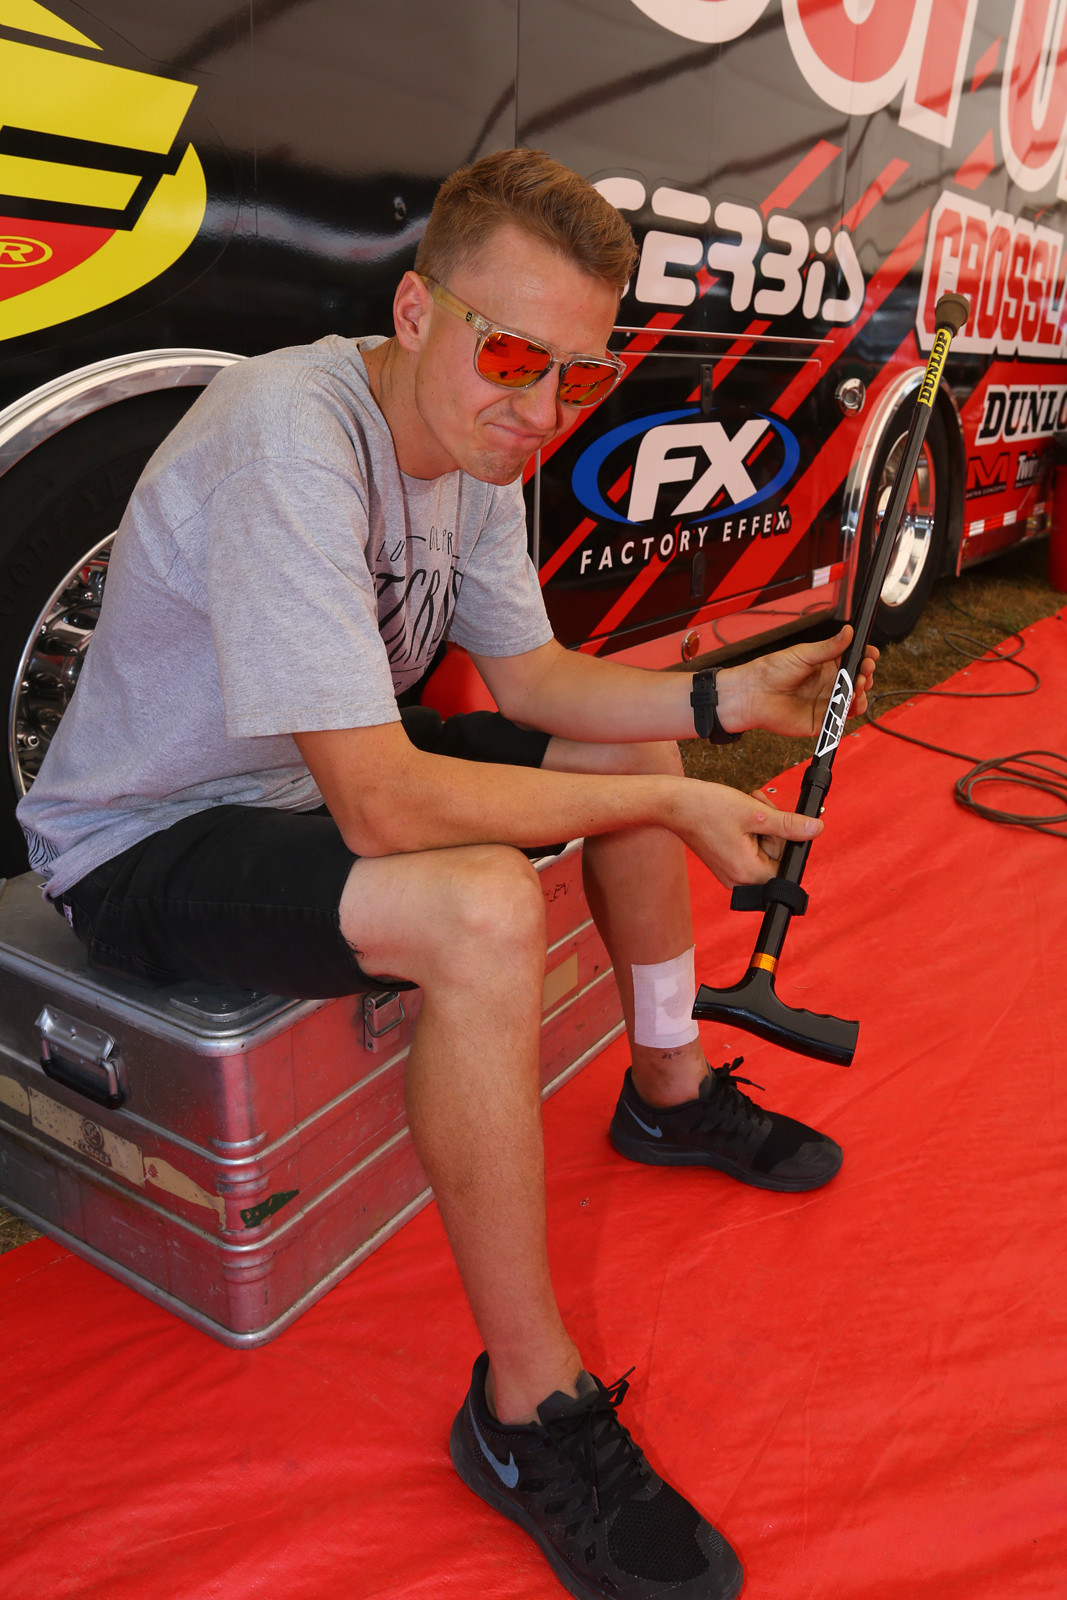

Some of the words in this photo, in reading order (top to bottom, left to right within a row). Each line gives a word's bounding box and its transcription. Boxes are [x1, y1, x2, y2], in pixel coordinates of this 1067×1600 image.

[919, 330, 950, 404] DUNLOP
[627, 418, 770, 522] FX
[578, 526, 708, 575] FACTORY
[722, 510, 788, 543] EFFEX
